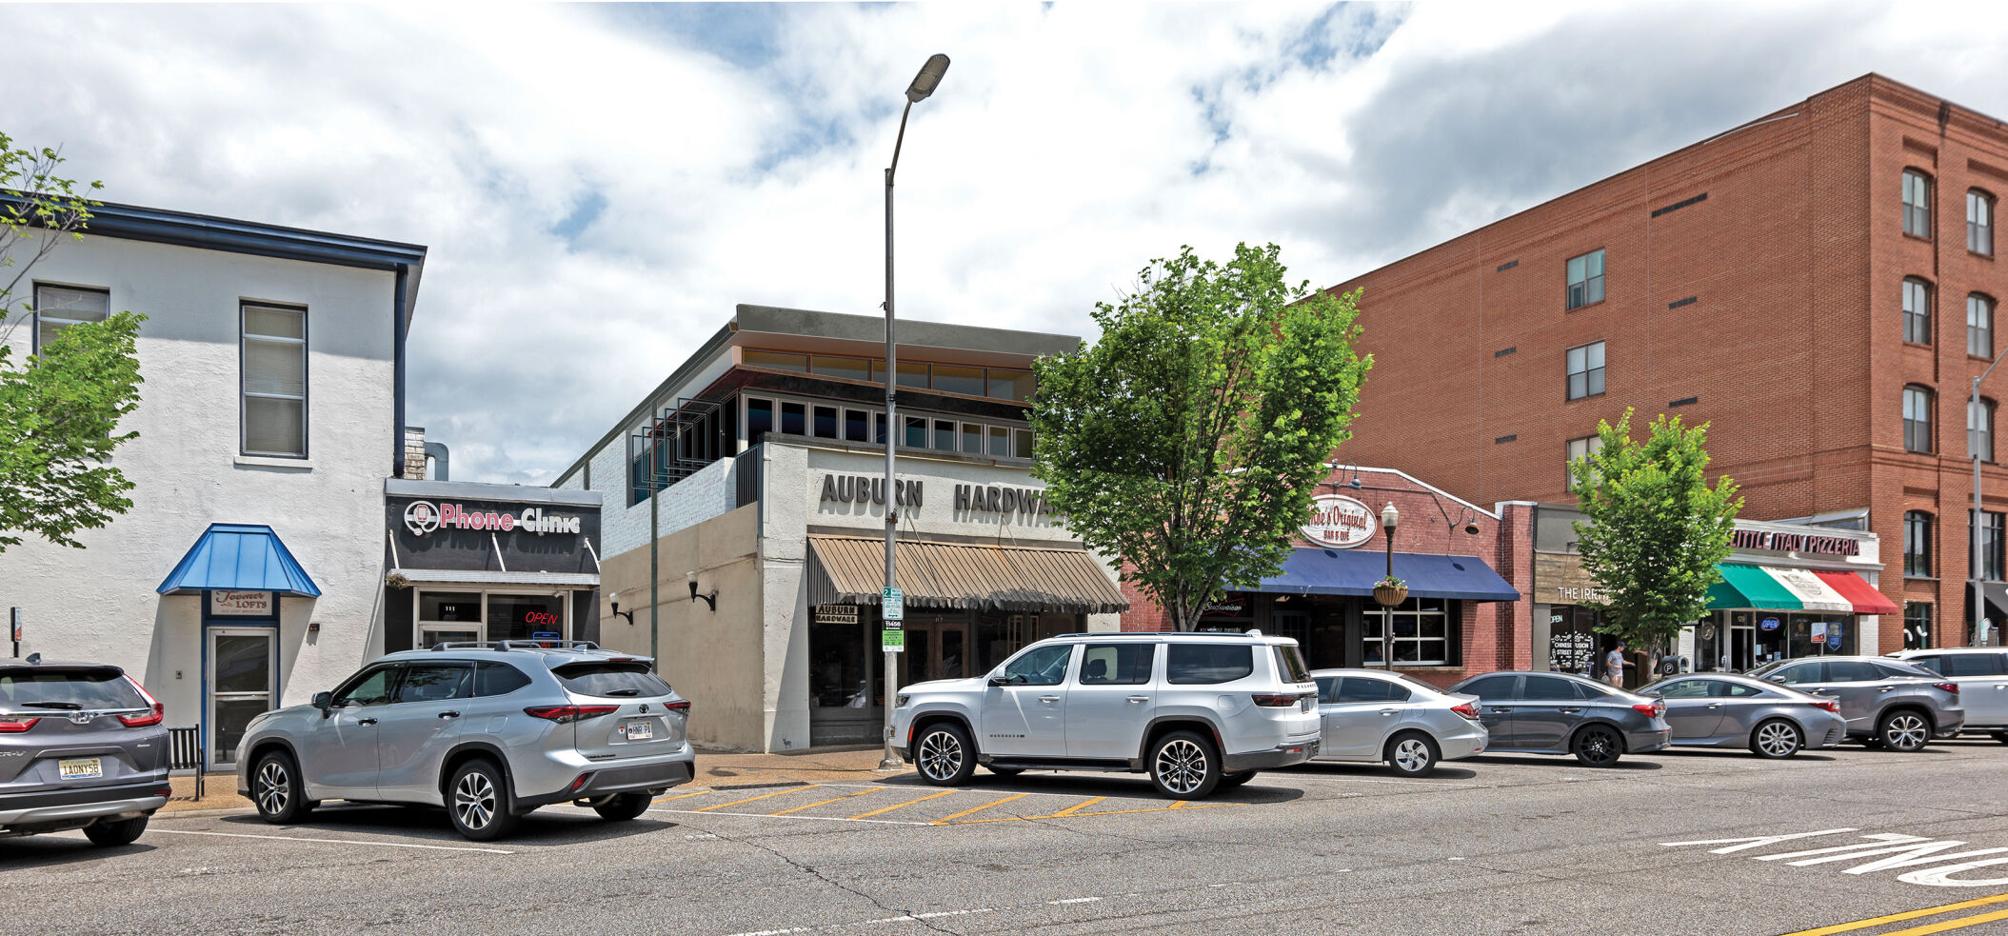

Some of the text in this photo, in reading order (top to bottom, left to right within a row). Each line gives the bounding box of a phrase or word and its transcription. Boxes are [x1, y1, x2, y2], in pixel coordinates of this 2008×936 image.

[821, 474, 1058, 515] AUBURN HARDWA
[439, 503, 581, 534] Phone Clinic
[1729, 529, 1860, 556] LITTLE ITALY PIZZERIA
[1558, 586, 1578, 599] THE
[236, 601, 267, 609] LOFTS
[818, 605, 855, 614] AUBURN
[524, 611, 559, 625] OPEN
[1762, 619, 1777, 629] OPEN
